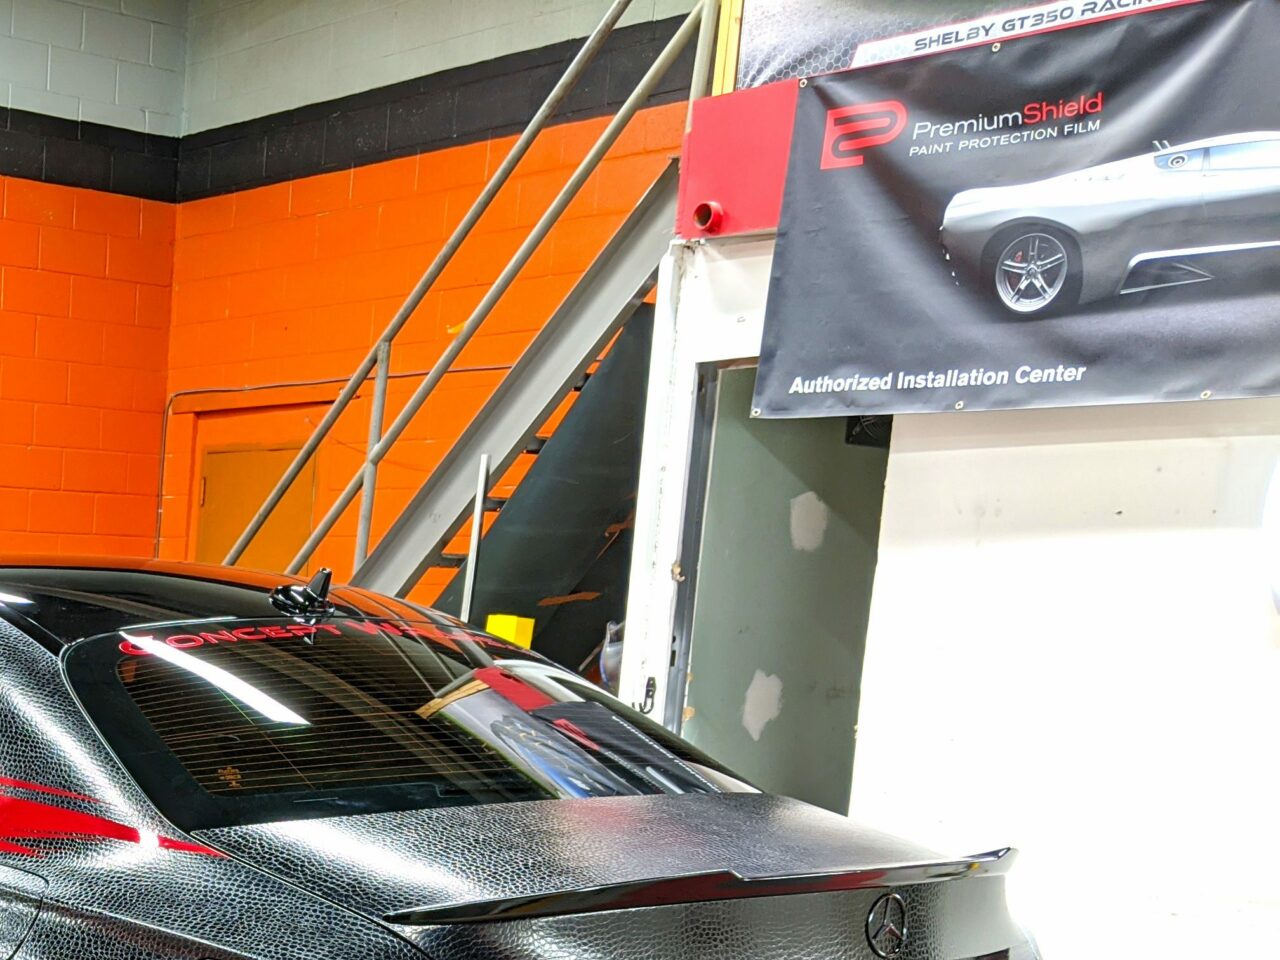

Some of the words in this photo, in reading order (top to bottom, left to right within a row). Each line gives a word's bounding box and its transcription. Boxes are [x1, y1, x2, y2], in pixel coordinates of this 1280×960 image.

[914, 22, 995, 52] SHELBY
[1001, 6, 1074, 32] GT350
[912, 92, 1104, 140] PremiumShield
[909, 142, 953, 157] PAINT
[958, 127, 1058, 151] PROTECTION
[1064, 119, 1101, 136] FILM
[788, 372, 893, 394] Authorized
[897, 369, 1009, 390] Installation
[1015, 364, 1087, 384] Center
